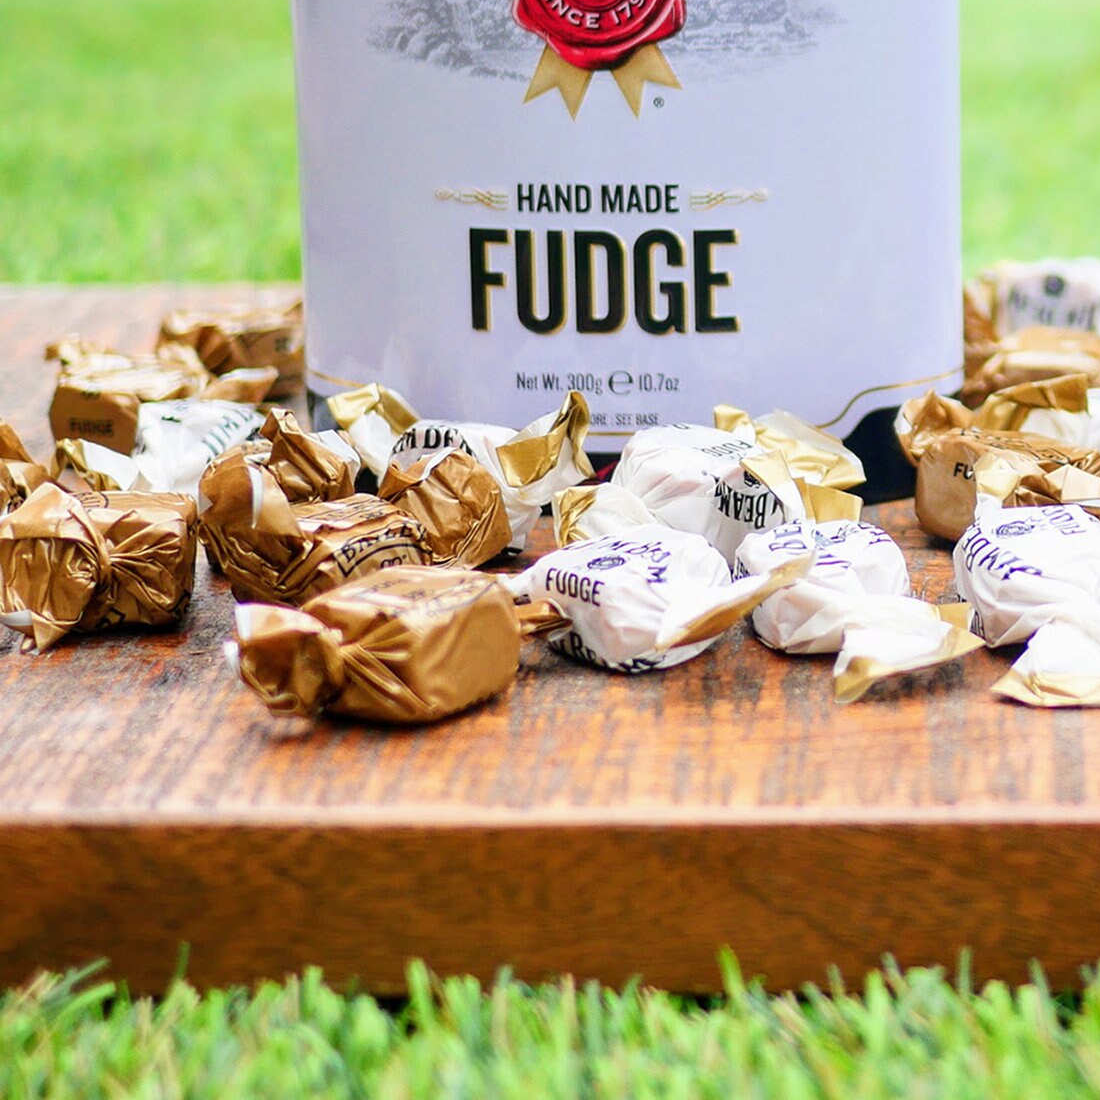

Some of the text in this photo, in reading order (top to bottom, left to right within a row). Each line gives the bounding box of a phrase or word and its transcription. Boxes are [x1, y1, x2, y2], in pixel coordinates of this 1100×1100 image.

[516, 183, 680, 214] HAND MADE
[469, 227, 742, 335] FUDGE
[516, 372, 538, 391] Net
[567, 372, 603, 395] 300g
[638, 372, 680, 392] 10.7oz
[635, 412, 660, 426] BASE
[546, 567, 606, 607] FUDGE
